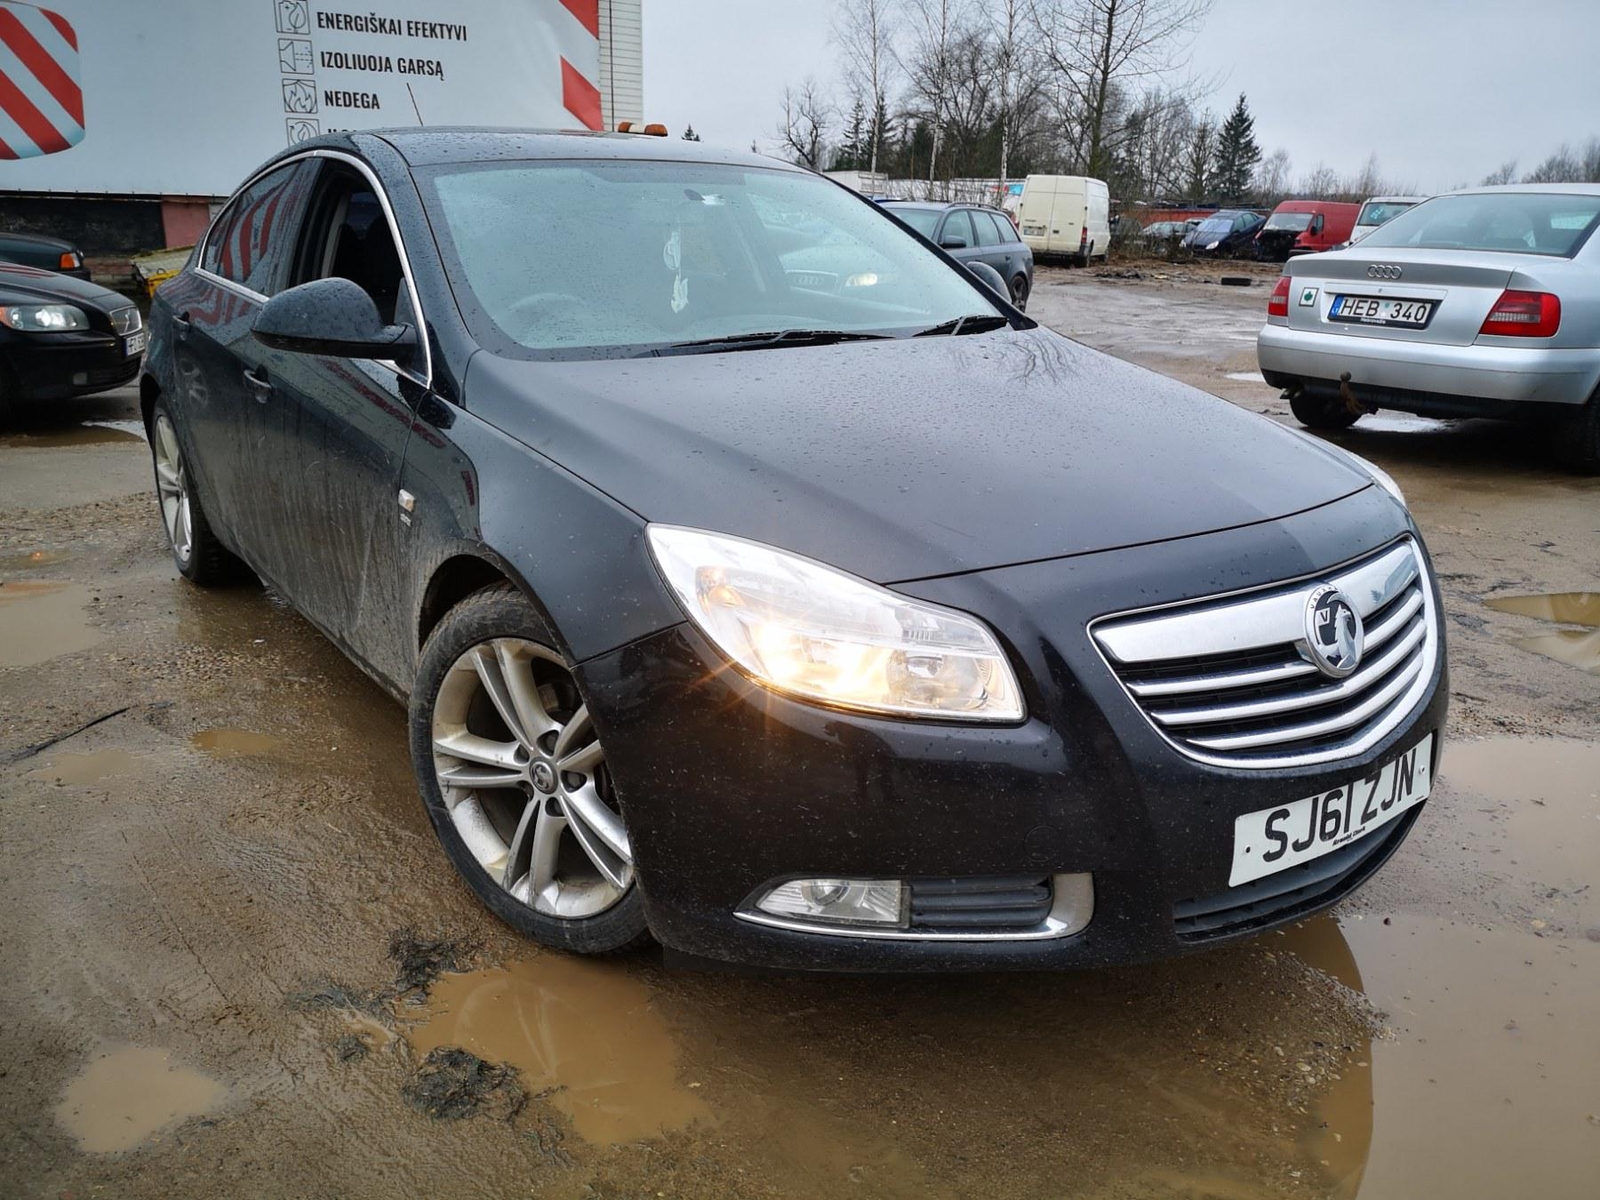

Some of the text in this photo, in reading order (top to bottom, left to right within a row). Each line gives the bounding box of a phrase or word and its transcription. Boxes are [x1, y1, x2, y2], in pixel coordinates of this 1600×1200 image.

[316, 11, 467, 41] ENERGIŠKAI EFEKTYVI
[320, 51, 445, 81] IZOLIUOJA GARSĄ
[324, 90, 380, 109] NEDEGA
[1340, 298, 1427, 321] HEB 340
